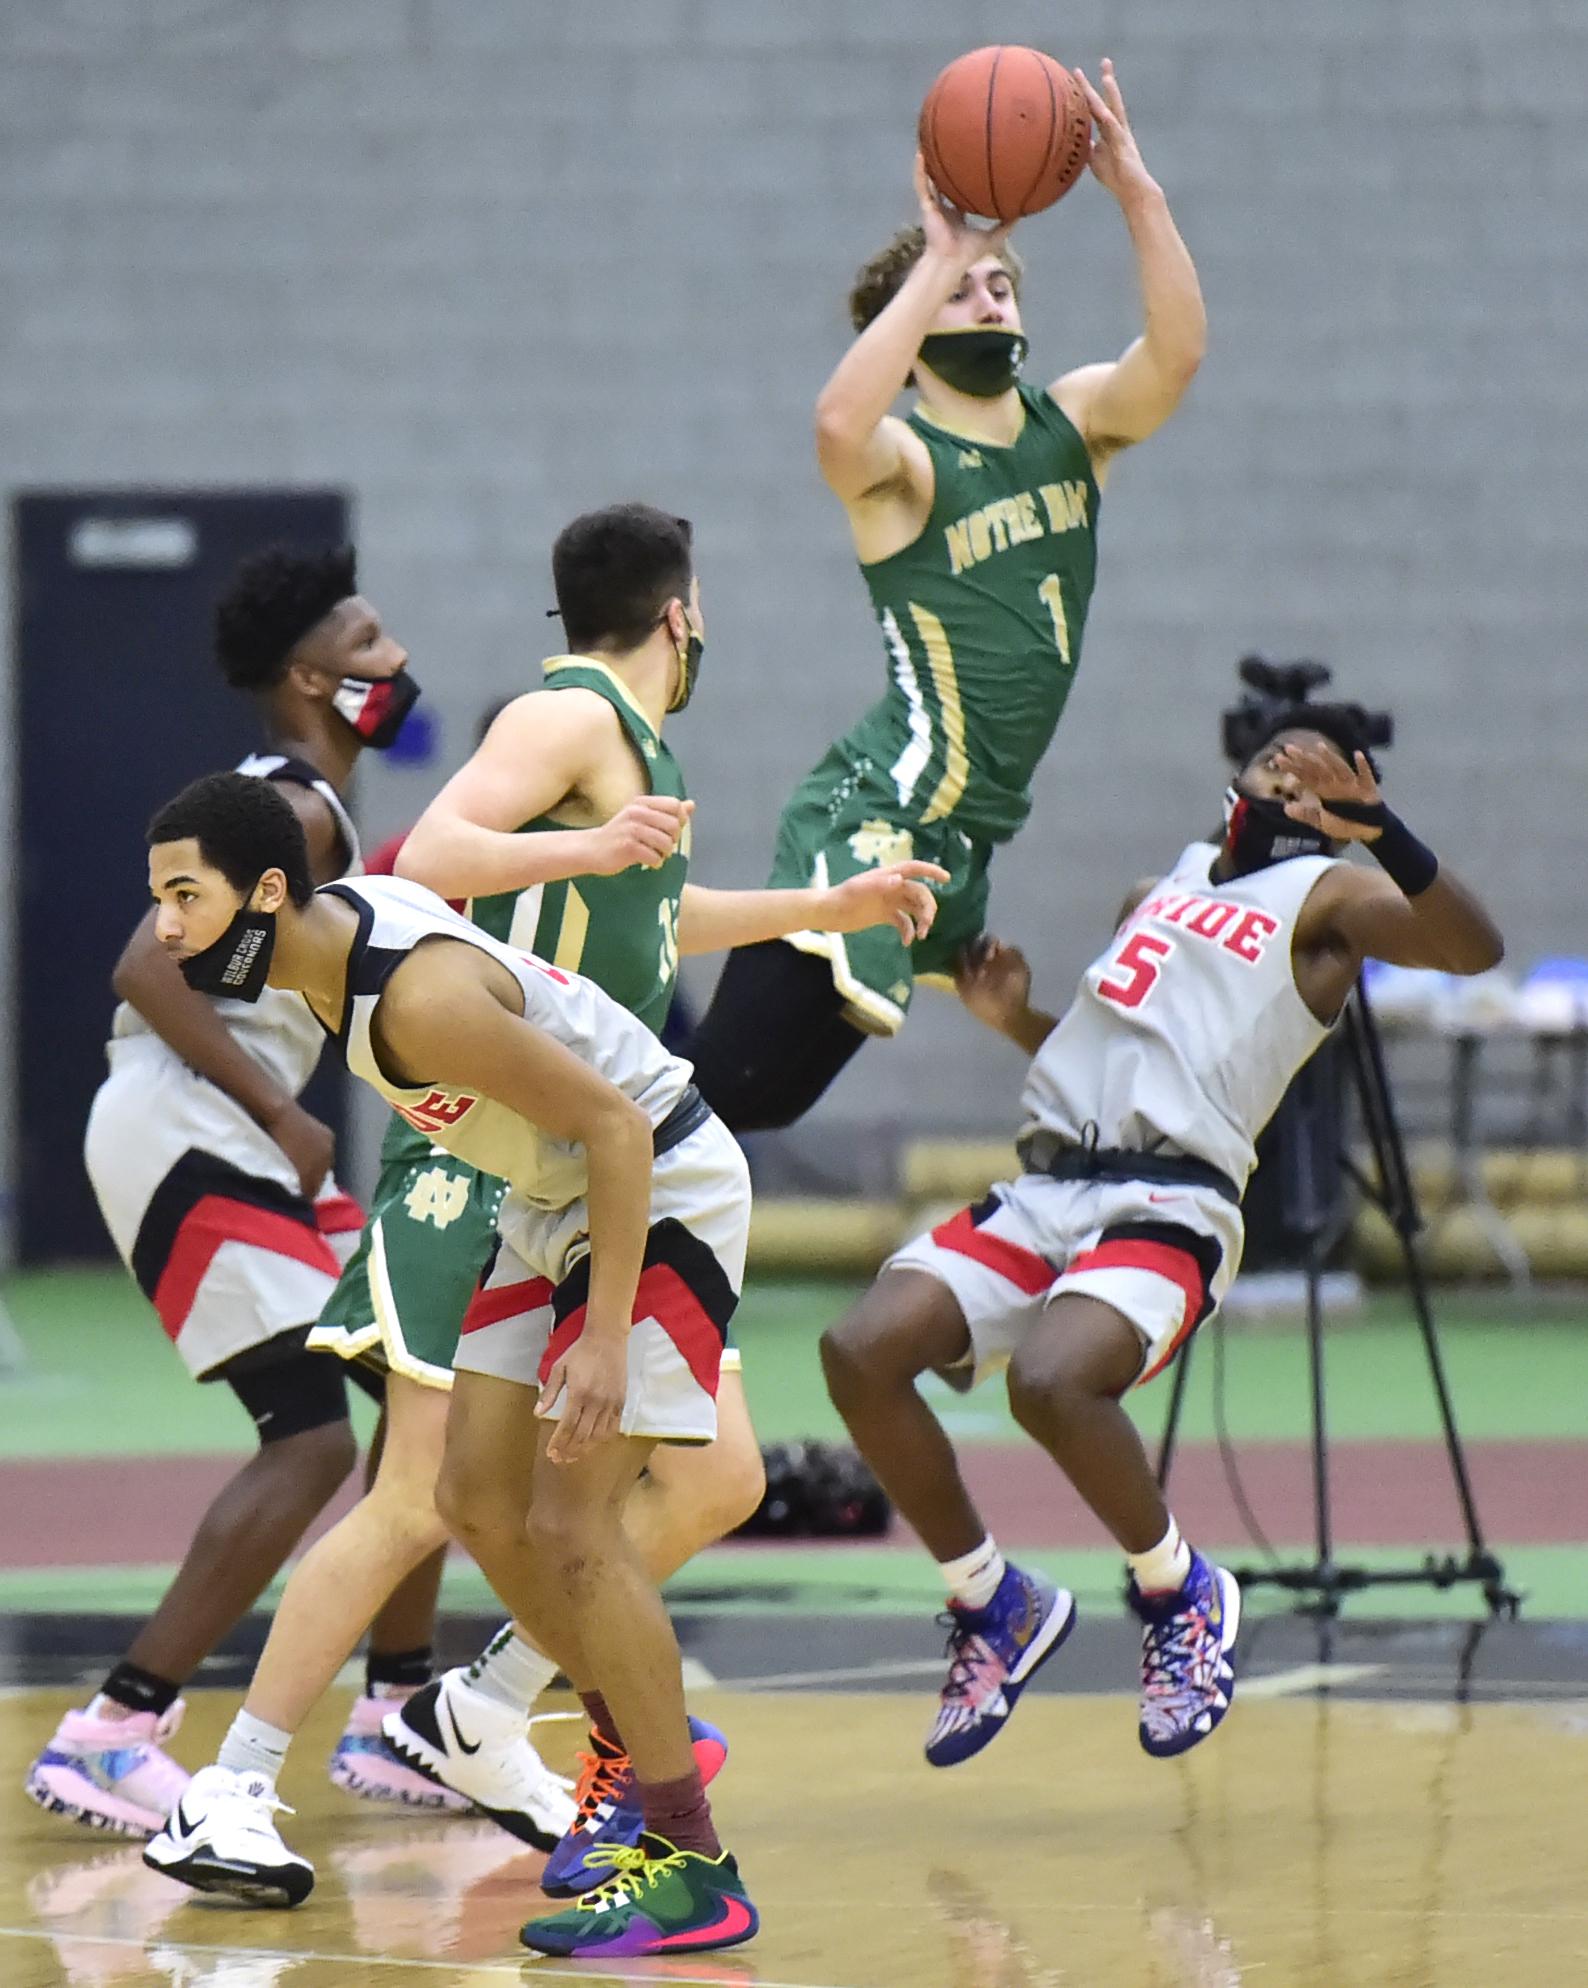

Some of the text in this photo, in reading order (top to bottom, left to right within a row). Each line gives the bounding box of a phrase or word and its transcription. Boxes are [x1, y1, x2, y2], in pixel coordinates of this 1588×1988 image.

[1037, 573, 1071, 665] 1
[232, 929, 267, 986] GOVERNORS
[1096, 931, 1174, 1009] 5
